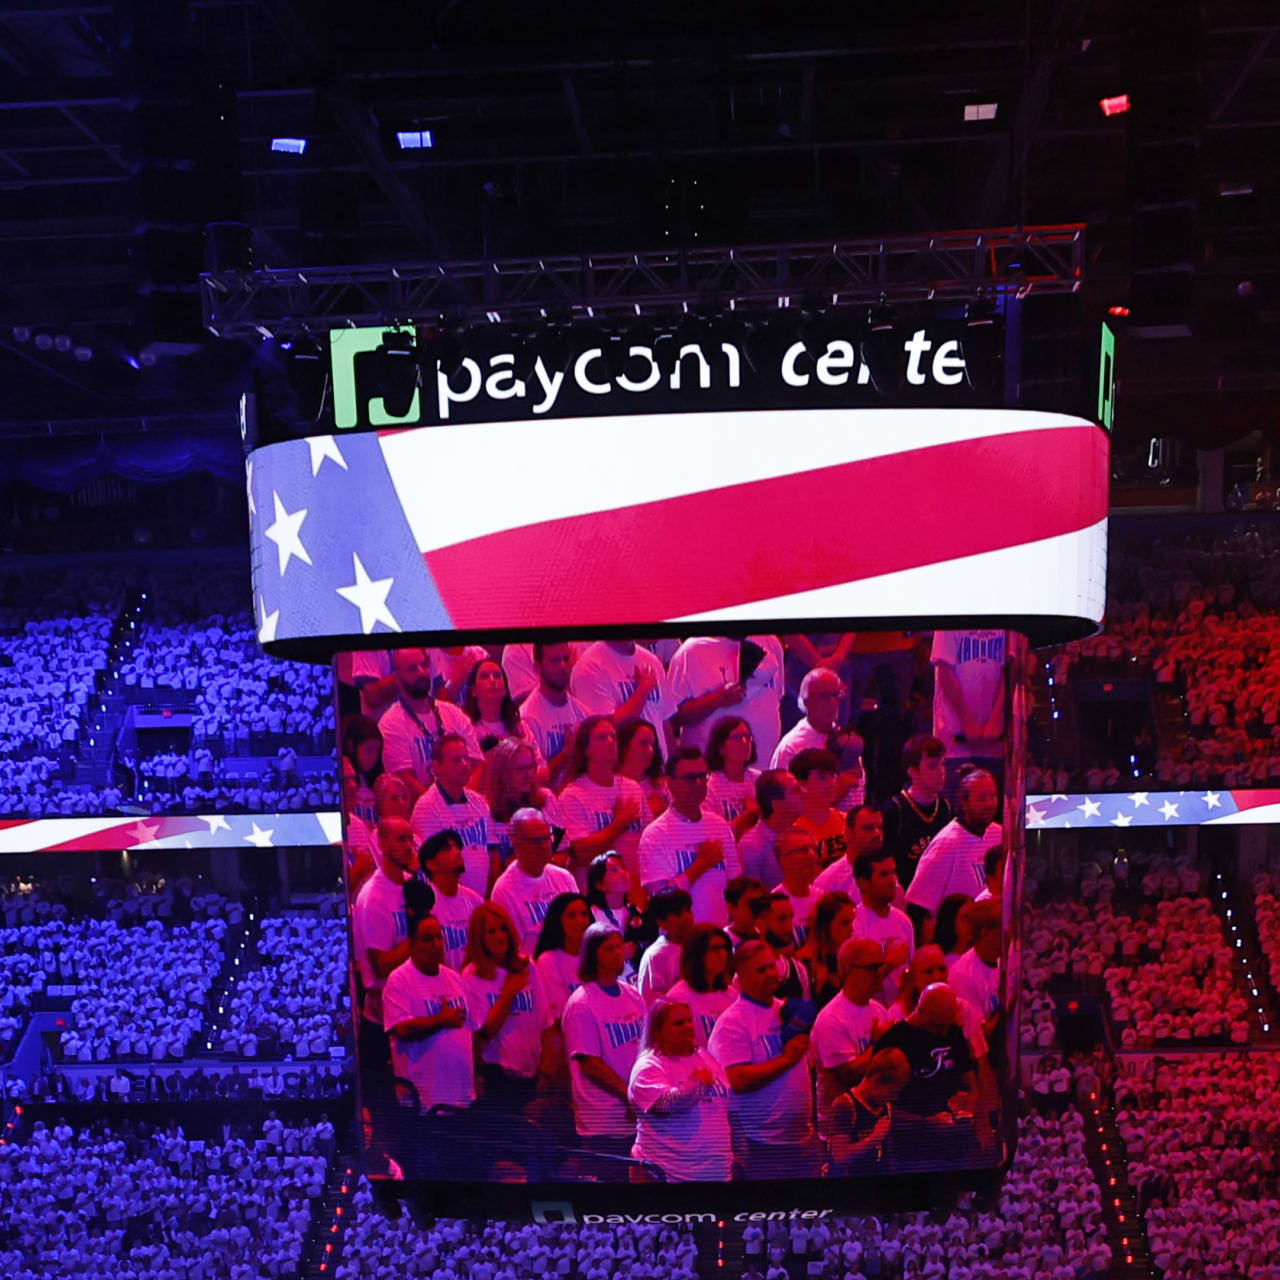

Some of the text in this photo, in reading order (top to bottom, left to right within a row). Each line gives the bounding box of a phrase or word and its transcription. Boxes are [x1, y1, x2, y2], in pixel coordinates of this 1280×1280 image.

[436, 342, 740, 419] paycom
[583, 1208, 834, 1225] paycom center
